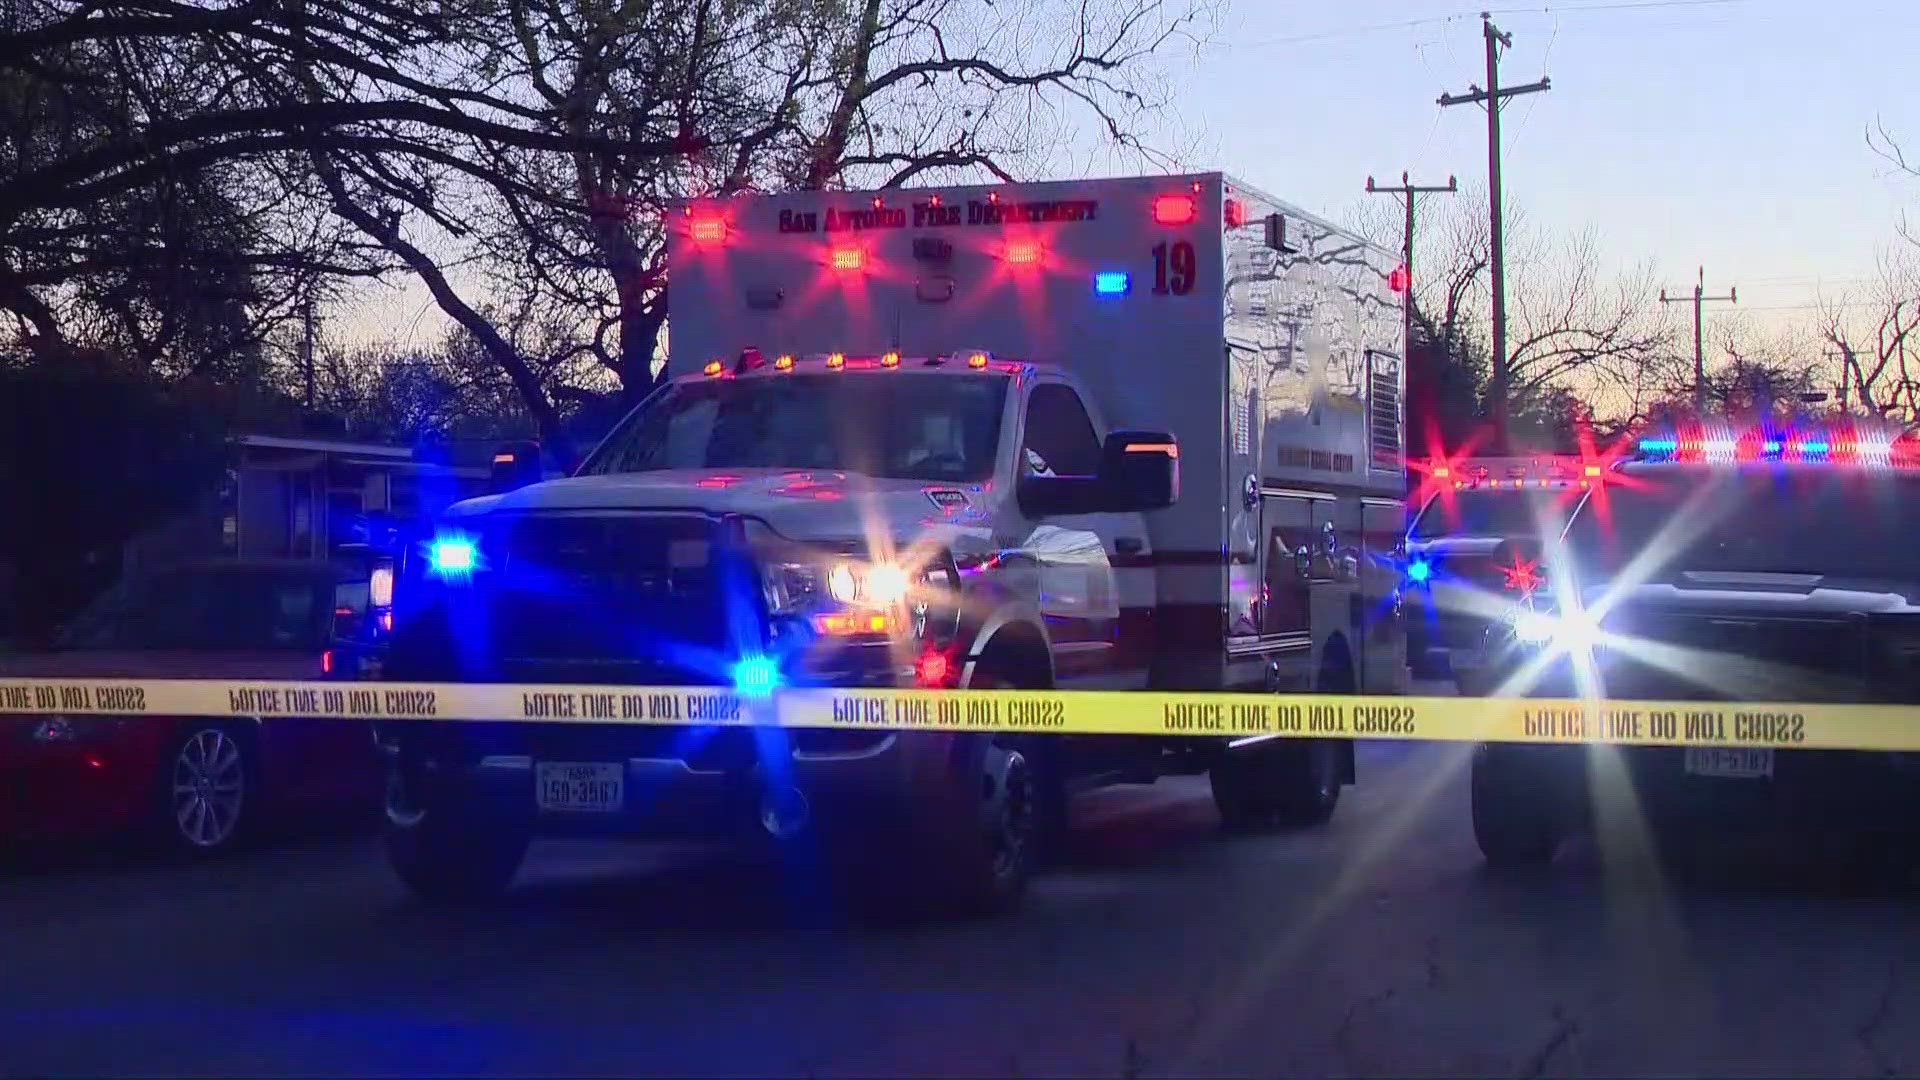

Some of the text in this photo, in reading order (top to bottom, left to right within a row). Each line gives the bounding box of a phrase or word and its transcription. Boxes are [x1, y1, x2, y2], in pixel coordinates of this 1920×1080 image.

[779, 199, 1097, 233] SAN ANTONIO FIRE DEPARTMENT
[1151, 240, 1196, 297] 19
